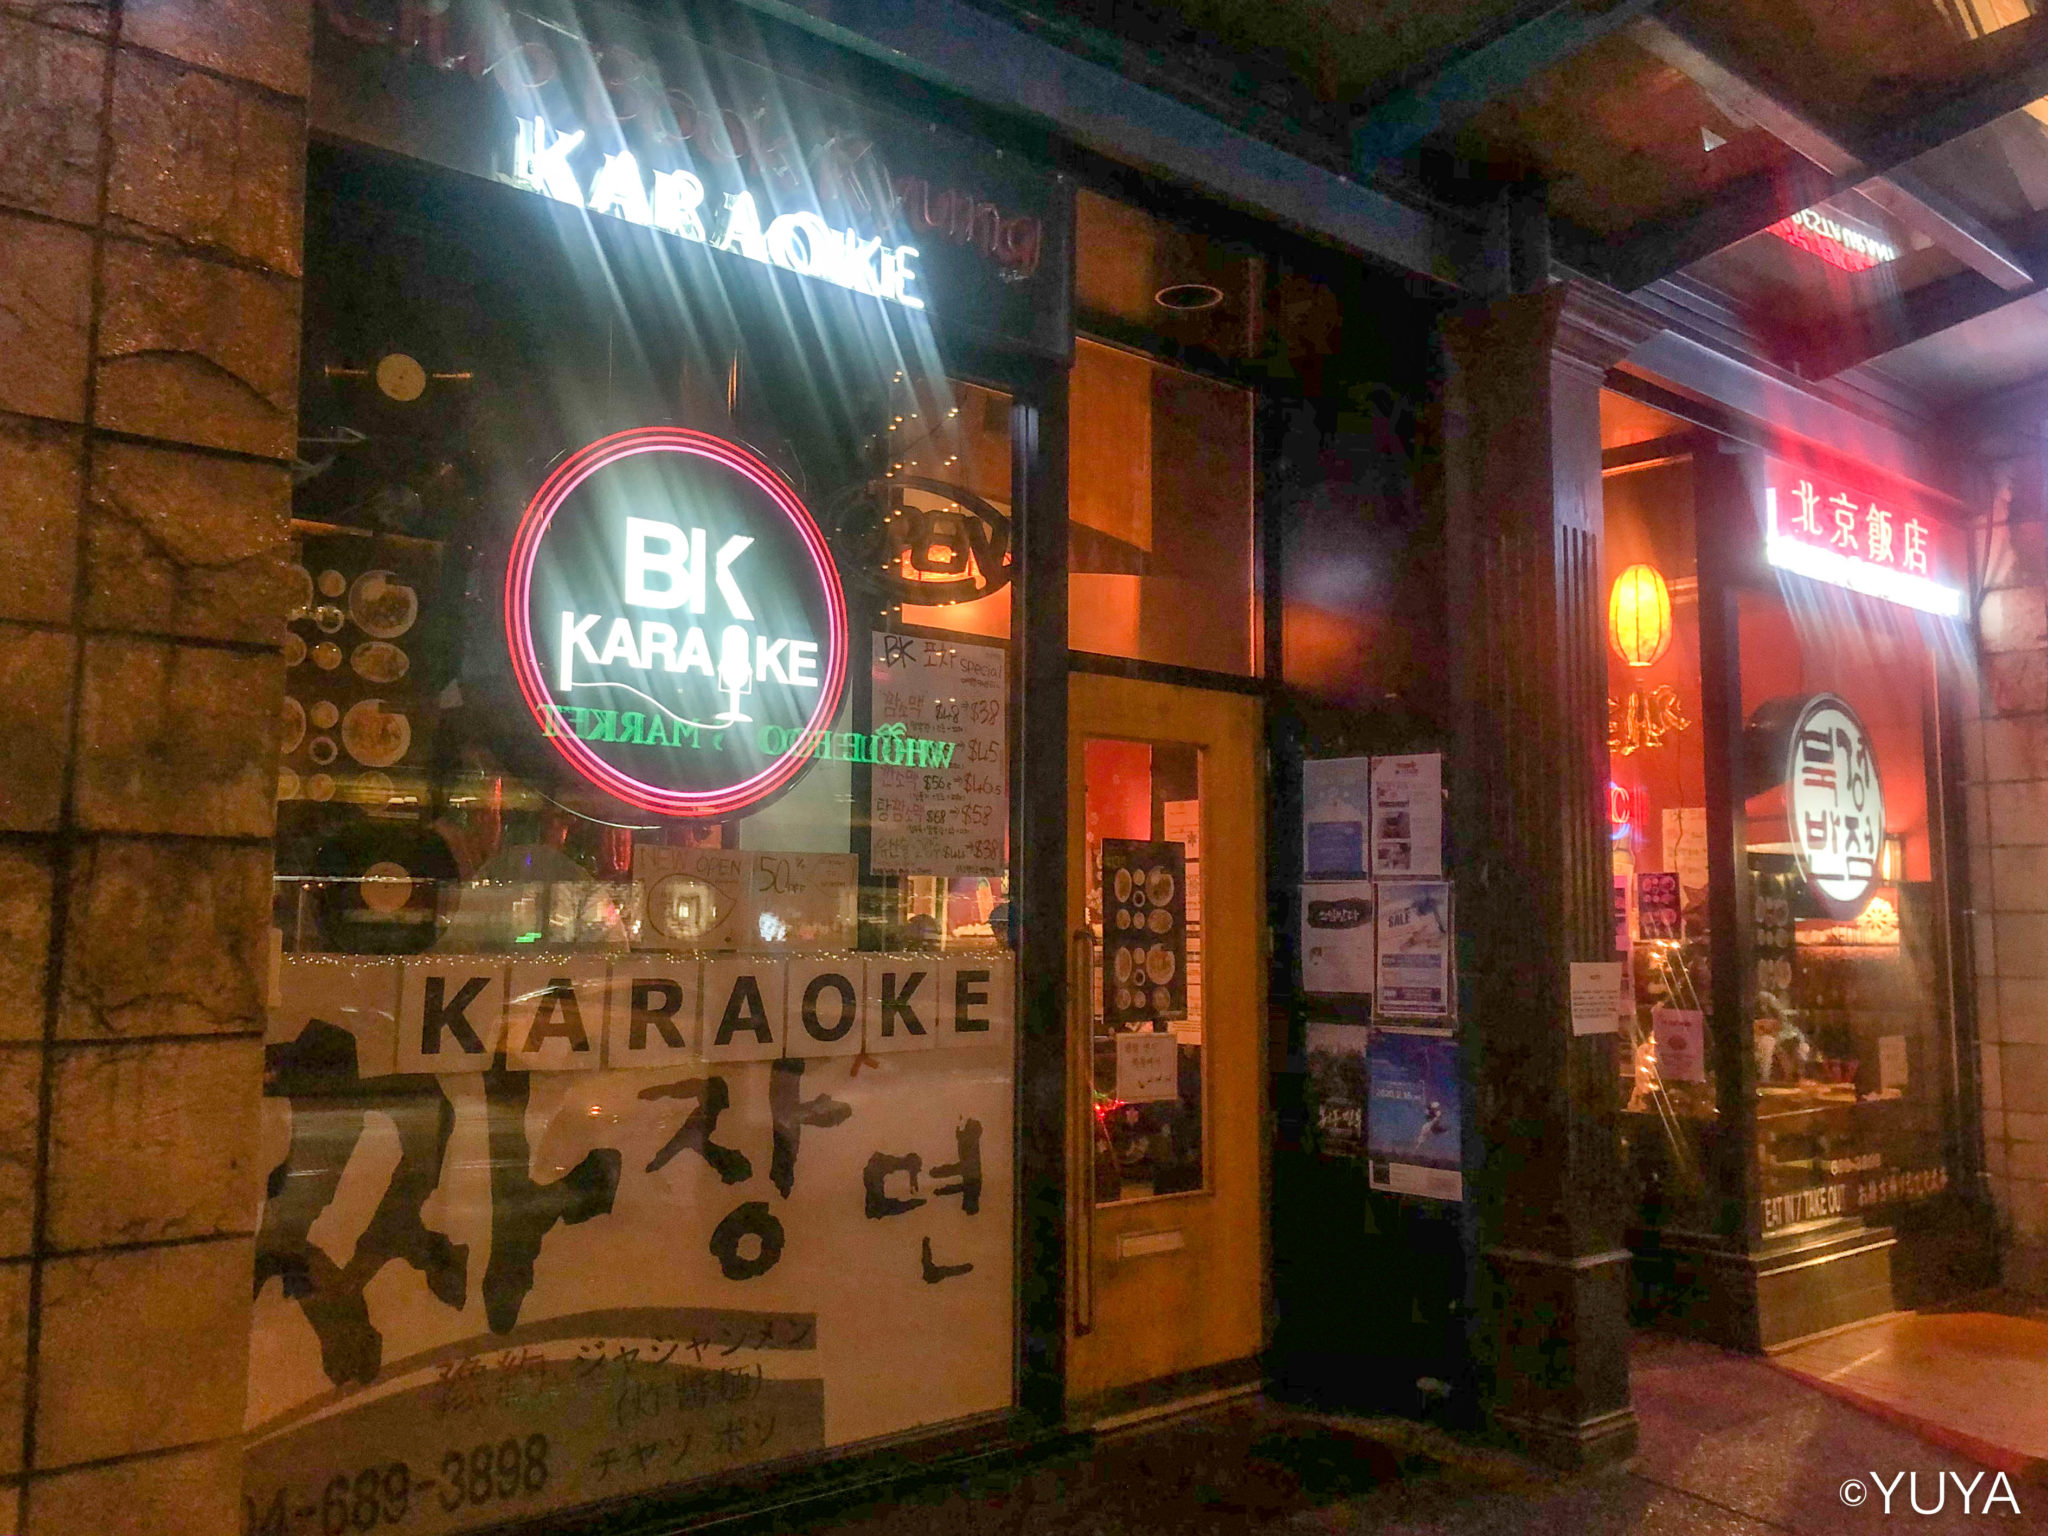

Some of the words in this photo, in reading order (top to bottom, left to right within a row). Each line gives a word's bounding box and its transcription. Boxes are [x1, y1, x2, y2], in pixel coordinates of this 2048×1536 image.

[514, 115, 925, 309] KARAOKE
[1790, 479, 1929, 575] 北京飯店
[624, 516, 755, 621] BK
[883, 634, 917, 669] BK
[969, 699, 1000, 725] $38
[696, 855, 741, 877] OPEN
[1387, 911, 1411, 929] SALE
[419, 968, 993, 1057] KARAOKE
[1763, 1196, 1783, 1228] EAT
[1784, 1193, 1795, 1224] IN
[1803, 1187, 1827, 1218] TAKE
[1828, 1183, 1846, 1214] OUT
